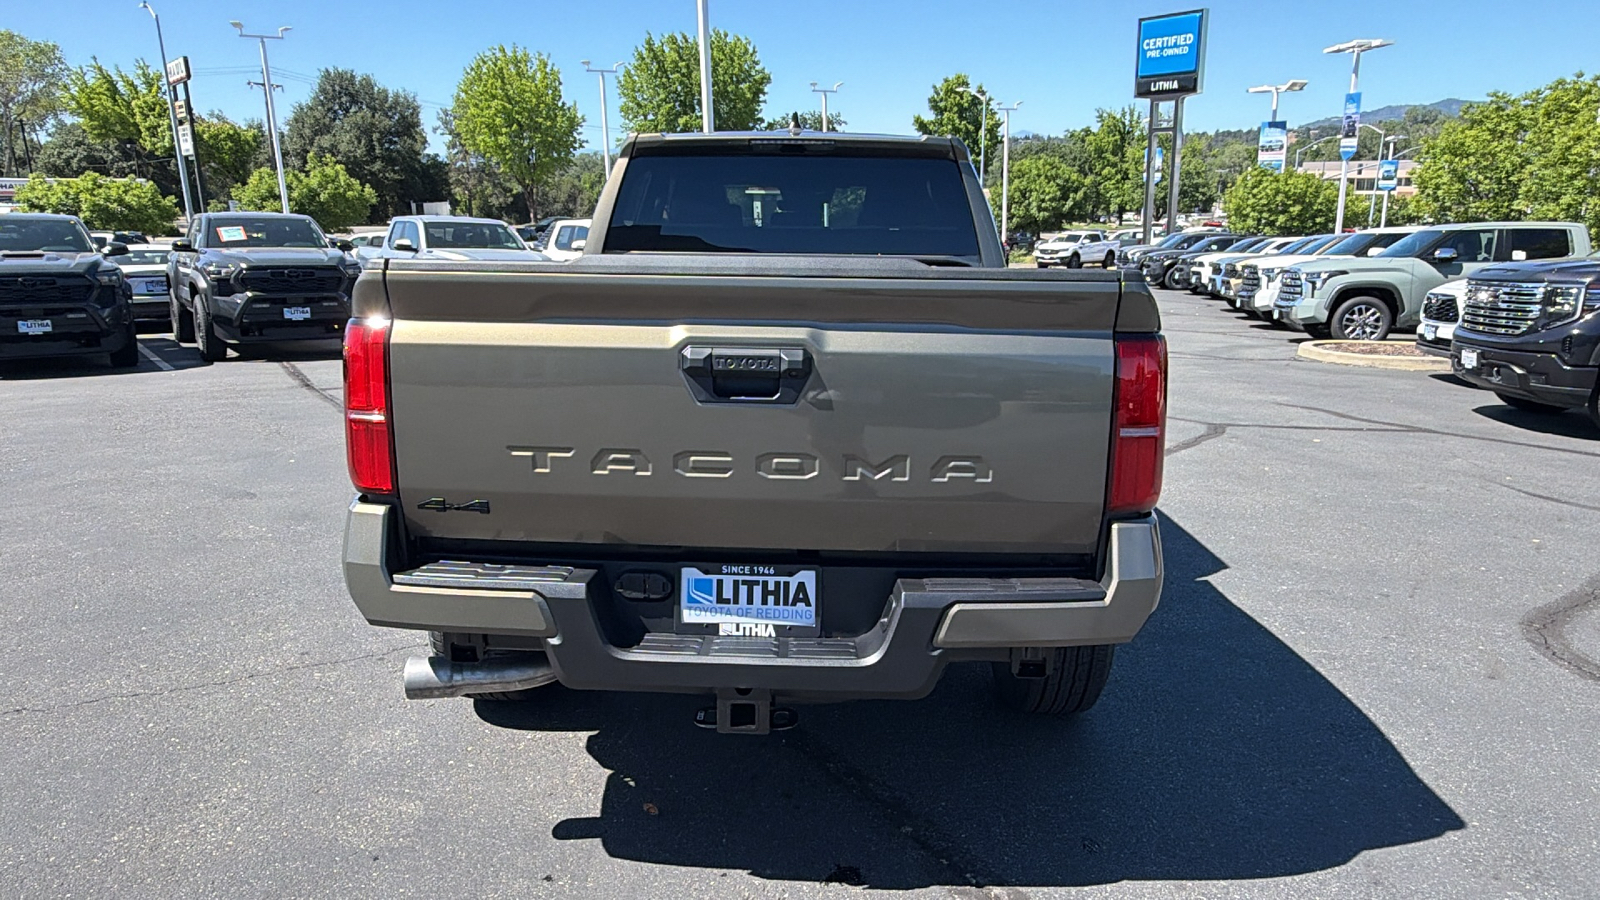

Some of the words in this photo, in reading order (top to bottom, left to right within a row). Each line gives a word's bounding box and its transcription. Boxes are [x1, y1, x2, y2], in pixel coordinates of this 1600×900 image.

[1143, 33, 1194, 50] CERTIFIED
[1146, 46, 1189, 59] PRE-OWNED
[1150, 79, 1179, 91] LITHIA
[715, 357, 778, 370] TOYOTA
[505, 444, 993, 483] TACOMA
[721, 565, 751, 574] SINCE
[753, 566, 775, 575] 1946
[716, 578, 812, 608] LITHIA
[686, 606, 733, 618] TOYOTA
[736, 608, 754, 618] OF
[756, 608, 813, 620] REDDING
[732, 622, 776, 637] LITHIA
